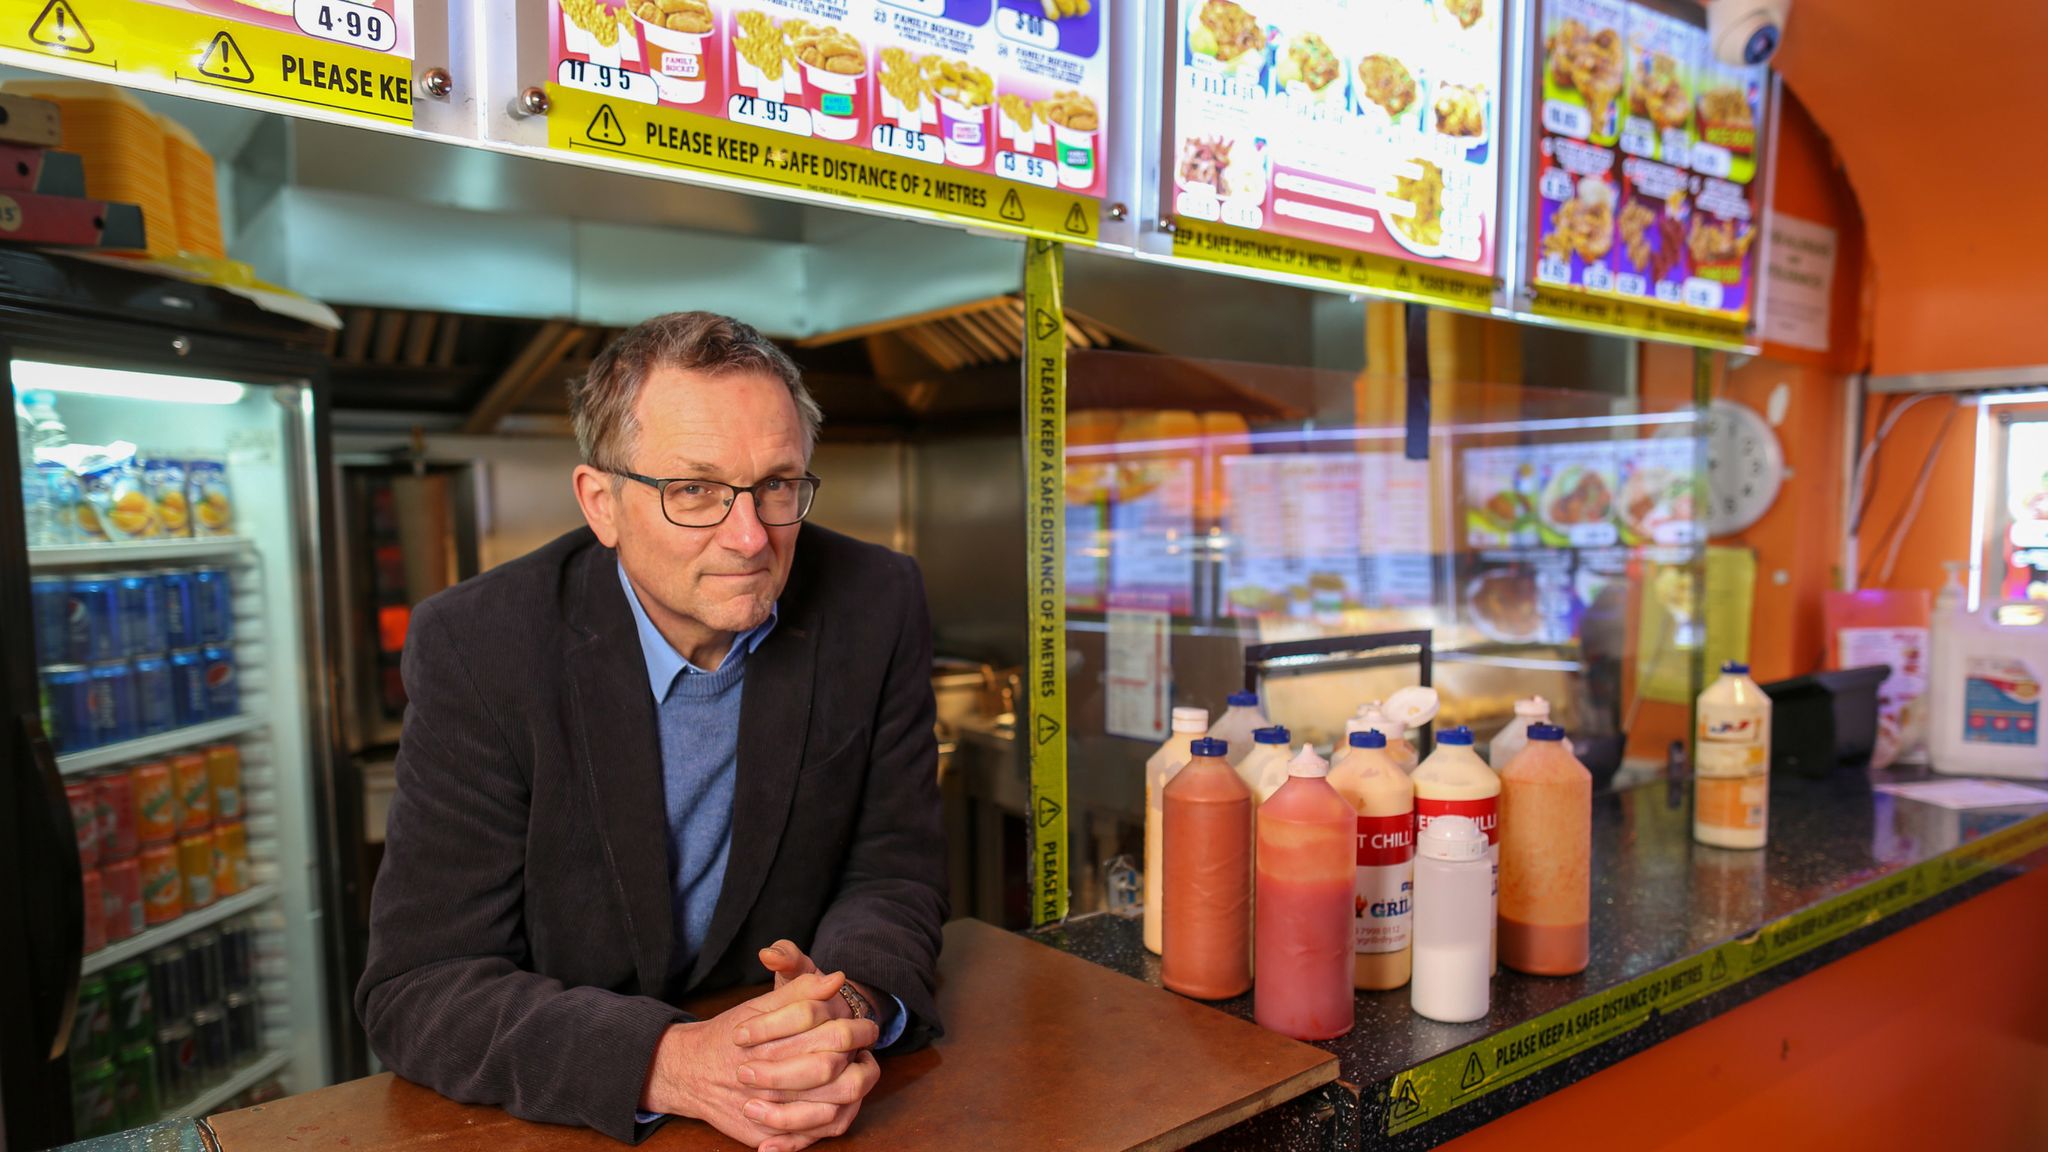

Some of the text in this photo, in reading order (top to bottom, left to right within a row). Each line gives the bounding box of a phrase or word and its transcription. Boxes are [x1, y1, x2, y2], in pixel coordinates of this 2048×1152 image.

[281, 54, 374, 98] PLEASE
[646, 121, 988, 208] PLEASE KEEP A SAFE DISTANCE OF 2 METRES
[1175, 228, 1193, 246] EEP
[1233, 237, 1282, 262] DISTANCE
[1040, 357, 1055, 415] PLEASE
[1040, 418, 1055, 458] KEEP
[1041, 461, 1054, 473] A
[1040, 477, 1055, 517] SAFE
[1040, 520, 1055, 591] DISTANCE
[1040, 594, 1055, 621] OF
[1040, 636, 1055, 698] METRES
[1043, 841, 1058, 896] PLEASE
[1496, 1034, 1537, 1068] PLEASE
[1538, 1023, 1564, 1051] KEEP
[1565, 1021, 1574, 1040] A
[1576, 1008, 1601, 1034] SAFE
[1602, 986, 1648, 1024] DISTANCE
[1650, 981, 1663, 1001] OF
[1663, 981, 1669, 997] 2
[1671, 965, 1704, 992] METRES
